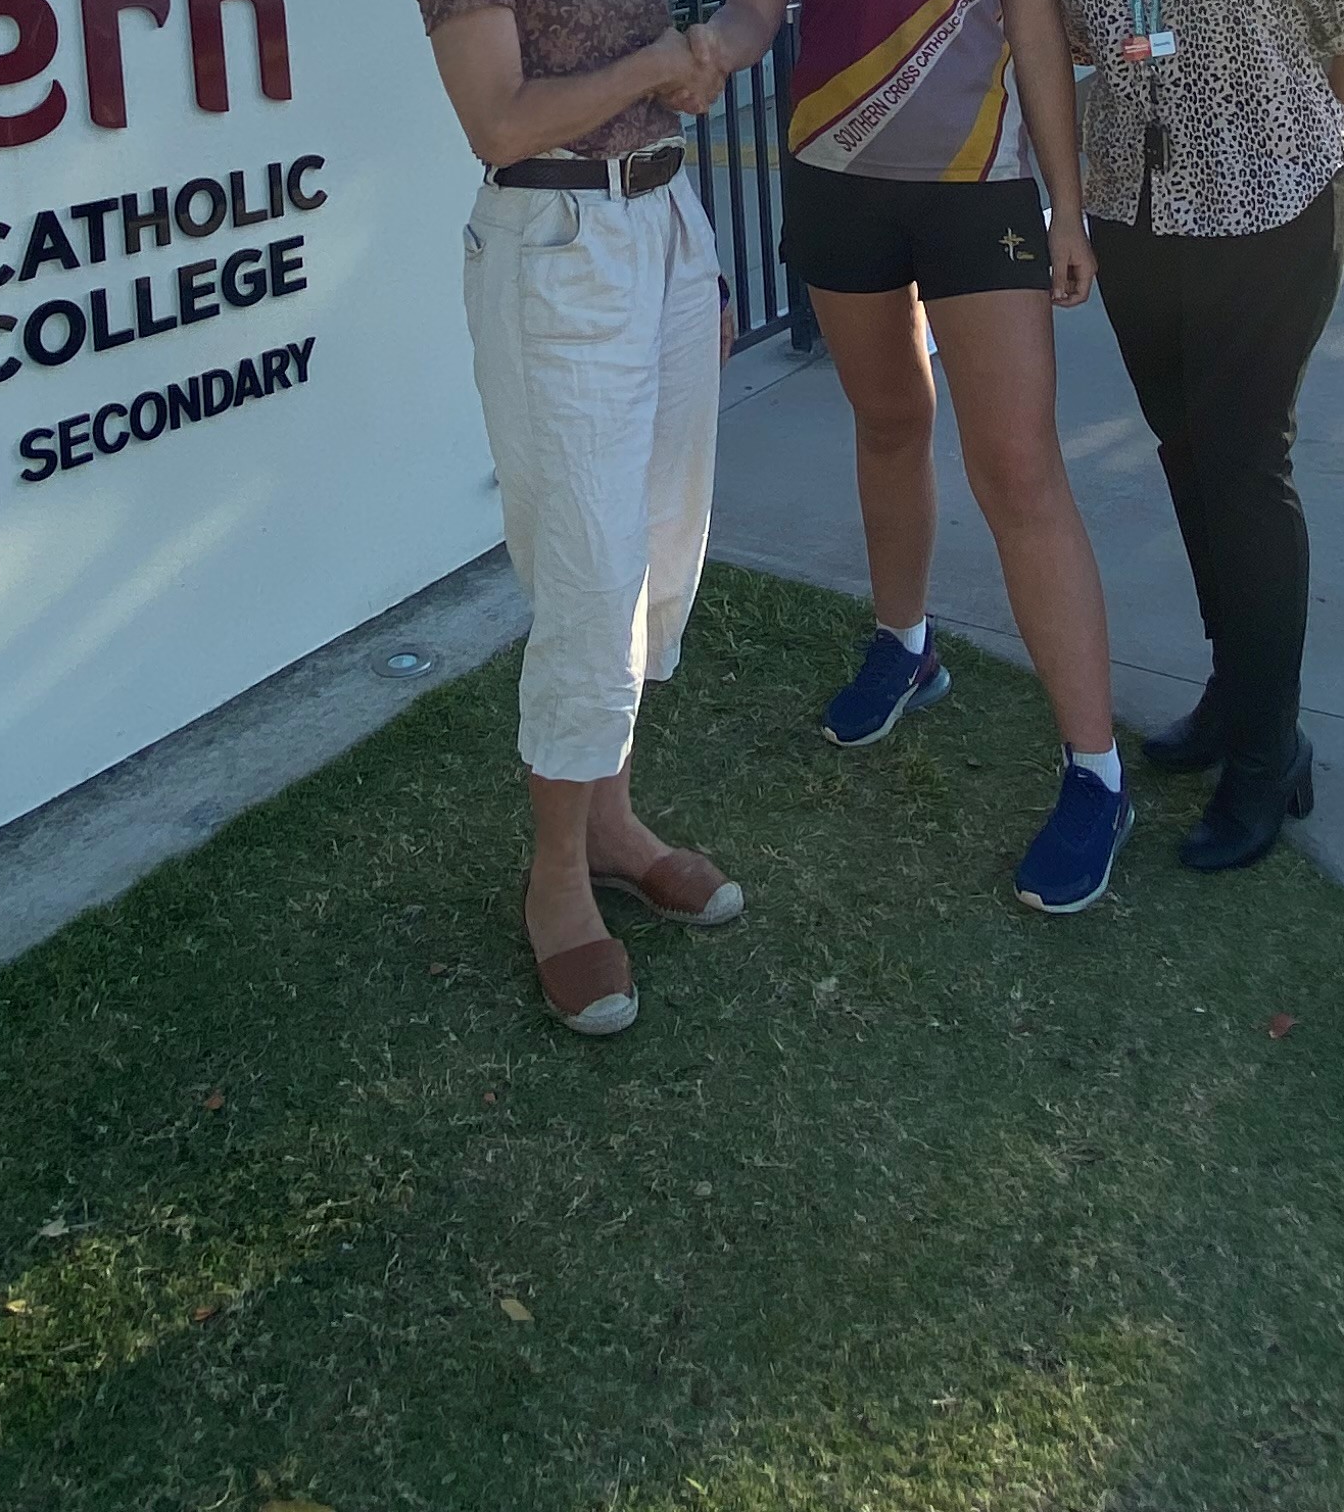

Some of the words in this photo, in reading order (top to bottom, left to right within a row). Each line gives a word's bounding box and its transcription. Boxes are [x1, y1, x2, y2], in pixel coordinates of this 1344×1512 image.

[832, 98, 891, 153] SOUTHERN
[883, 64, 921, 105] CROSS
[915, 15, 961, 68] CATHOLIC
[19, 337, 317, 483] SECONDARY
